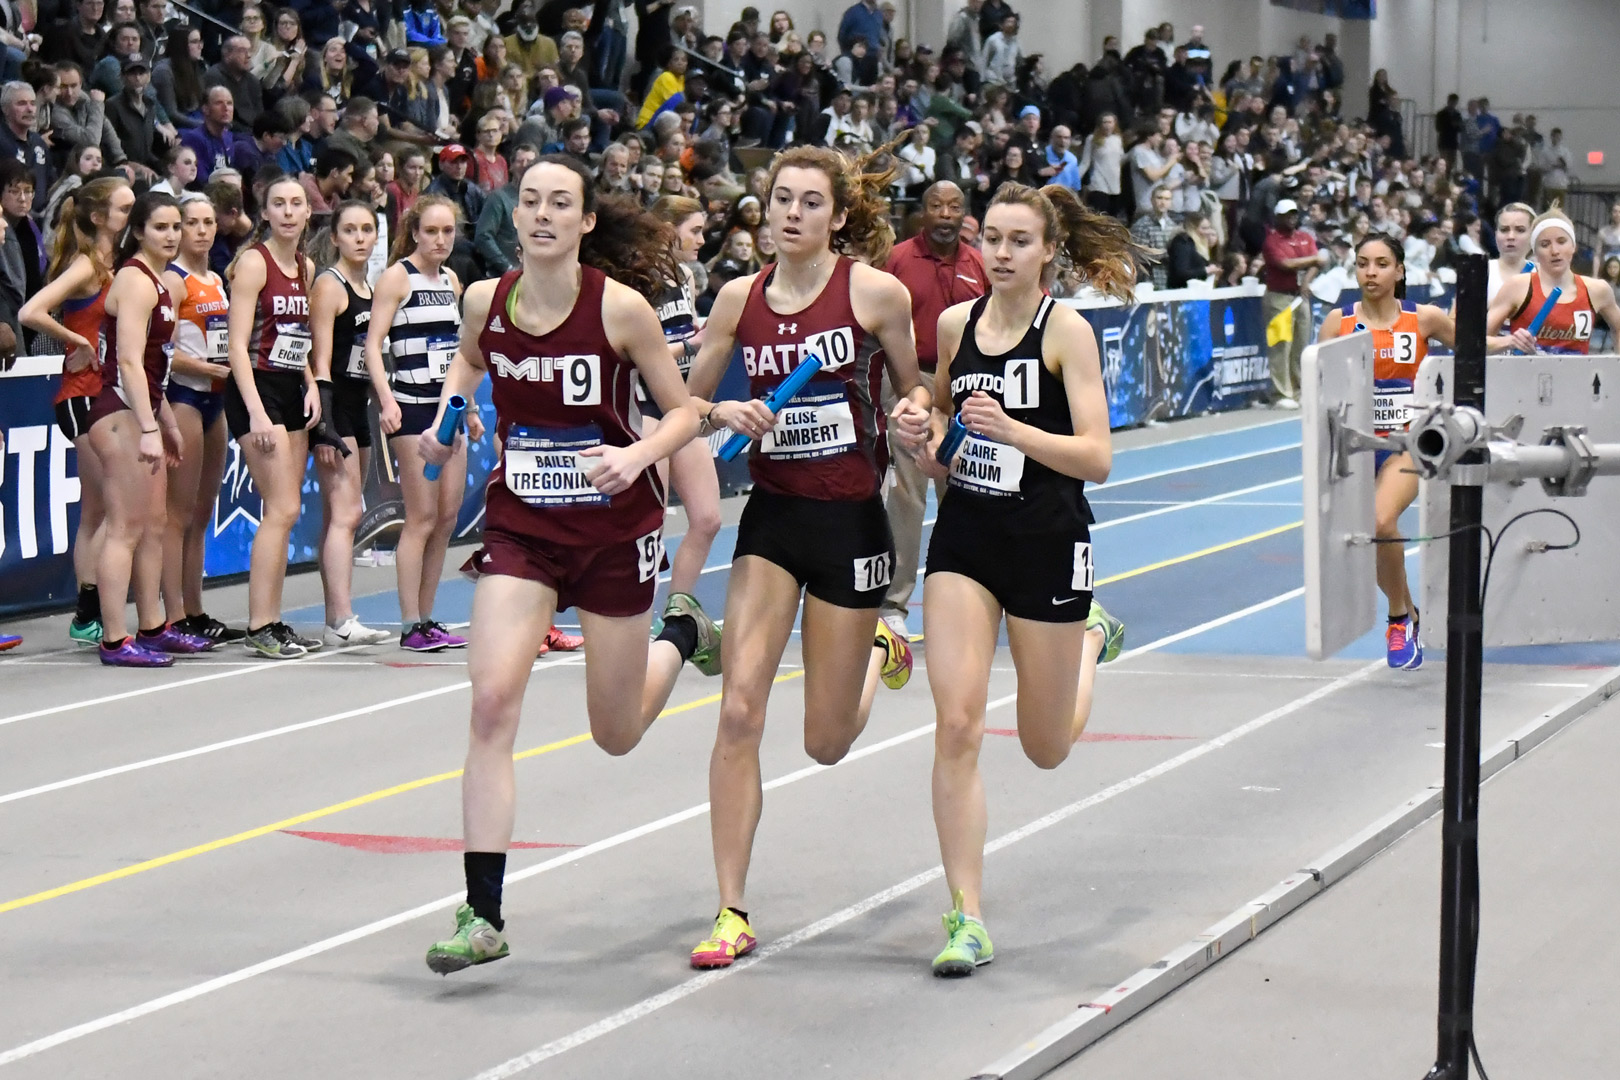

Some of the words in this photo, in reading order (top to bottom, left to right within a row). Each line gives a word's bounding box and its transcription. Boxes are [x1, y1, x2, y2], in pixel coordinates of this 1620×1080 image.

[273, 296, 310, 315] BATE
[1579, 313, 1589, 336] 2
[815, 331, 848, 366] 10
[1400, 334, 1412, 361] 3
[570, 358, 592, 402] 9
[951, 372, 1004, 399] BOWDO
[1012, 362, 1028, 405] 1
[1372, 398, 1394, 407] DORA
[1374, 408, 1408, 420] RENCE
[785, 411, 818, 425] ELISE
[773, 423, 839, 447] LAMBERT
[535, 456, 576, 468] BAILEY
[963, 440, 998, 462] CLAIRE
[512, 472, 593, 490] TREGONIN
[955, 457, 1001, 483] TRAUM
[644, 536, 655, 577] 9
[863, 555, 886, 588] 10
